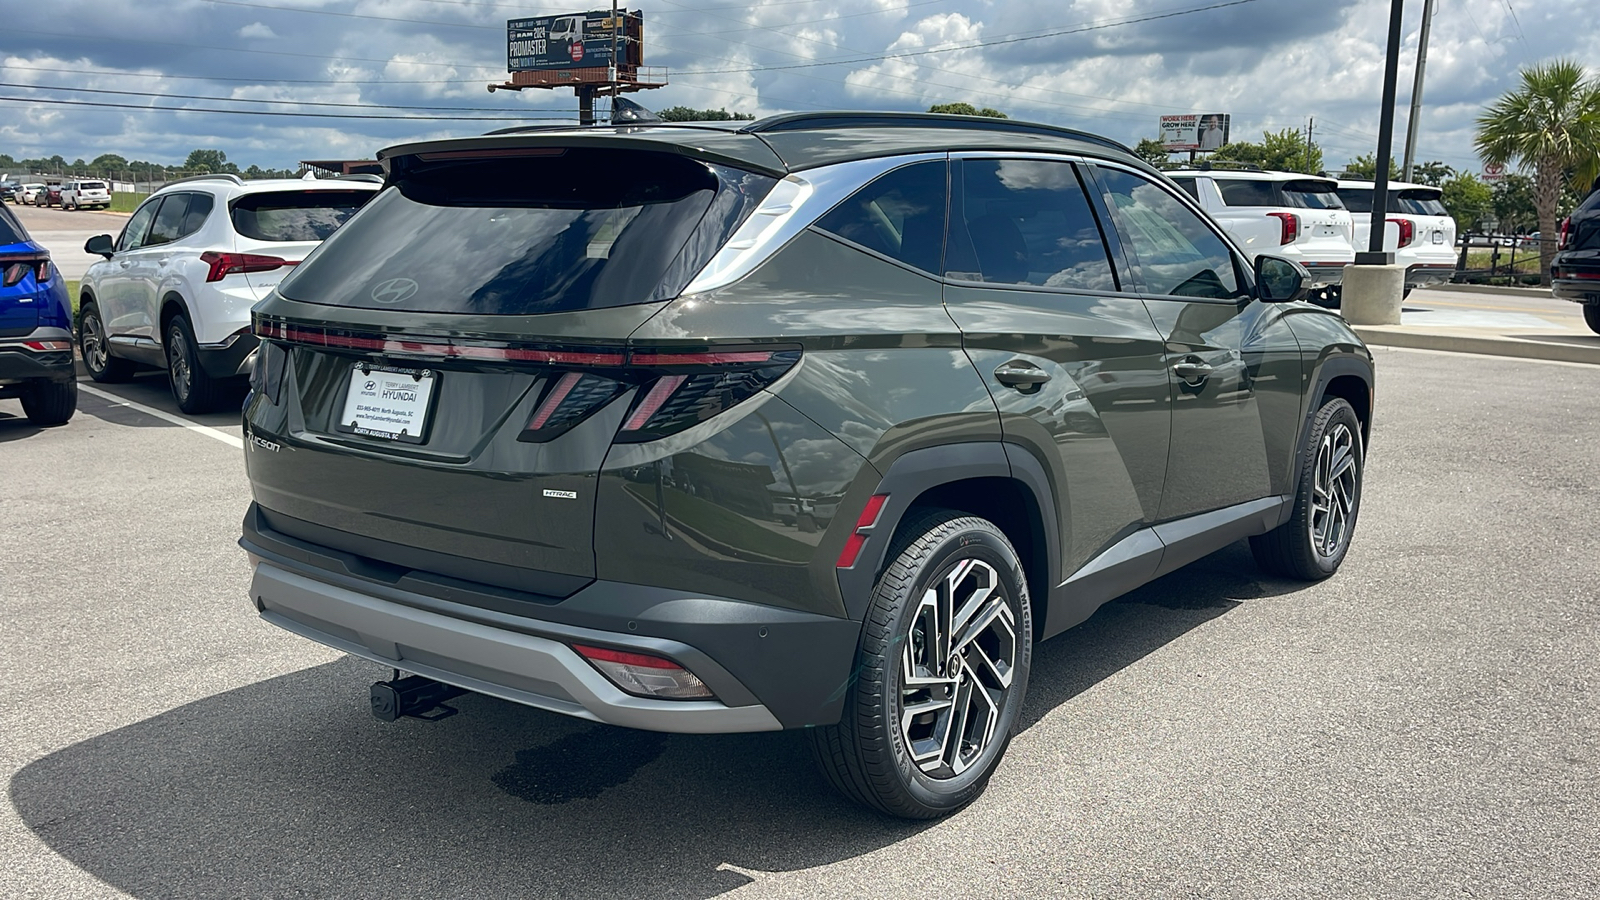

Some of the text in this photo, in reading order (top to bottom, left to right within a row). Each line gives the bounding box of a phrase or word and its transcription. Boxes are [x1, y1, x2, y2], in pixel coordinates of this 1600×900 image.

[534, 26, 546, 39] 2024
[509, 39, 547, 57] PROMASTER
[380, 365, 398, 373] LAMBERT
[382, 390, 417, 402] HYUNDAI
[353, 427, 370, 435] NORTH
[1020, 592, 1031, 667] MICHELIN
[890, 674, 902, 755] MICHELIN
